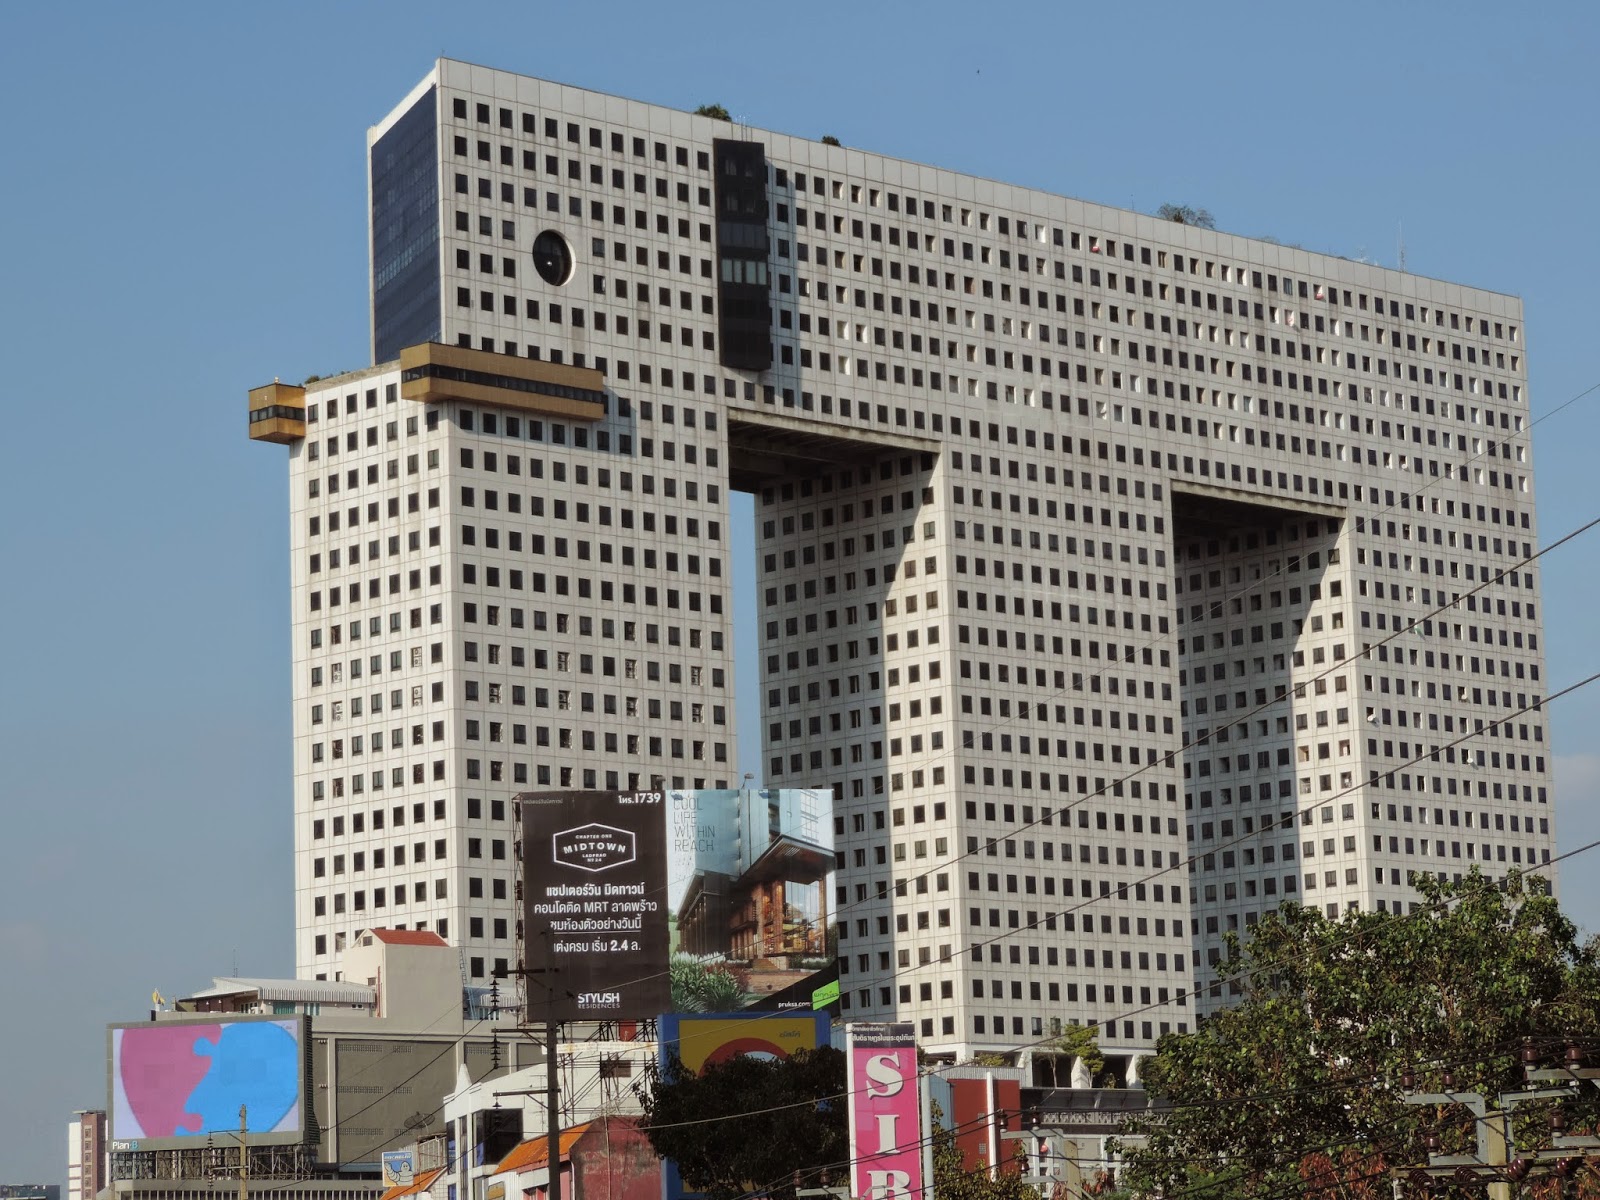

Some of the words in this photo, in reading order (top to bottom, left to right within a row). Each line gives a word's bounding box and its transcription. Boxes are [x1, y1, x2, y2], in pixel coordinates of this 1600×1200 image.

[673, 797, 704, 811] COOL
[673, 811, 698, 825] LIFE
[674, 825, 715, 838] WITHIN
[563, 842, 627, 855] MIDTOWN
[674, 839, 714, 852] REACH
[546, 883, 602, 897] แชปเตอร์วัน
[604, 882, 646, 896] มิดทาวน์
[534, 901, 581, 914] คอนโดติด
[584, 901, 609, 913] MRT
[611, 899, 658, 912] ลาดพร้าว
[591, 936, 608, 952] เริ่ม
[610, 939, 629, 952] 2.4
[577, 992, 620, 1004] STYLISH
[577, 1002, 621, 1010] RESIDENCES
[778, 1001, 811, 1009] pruksa.com
[112, 1141, 130, 1150] Plan
